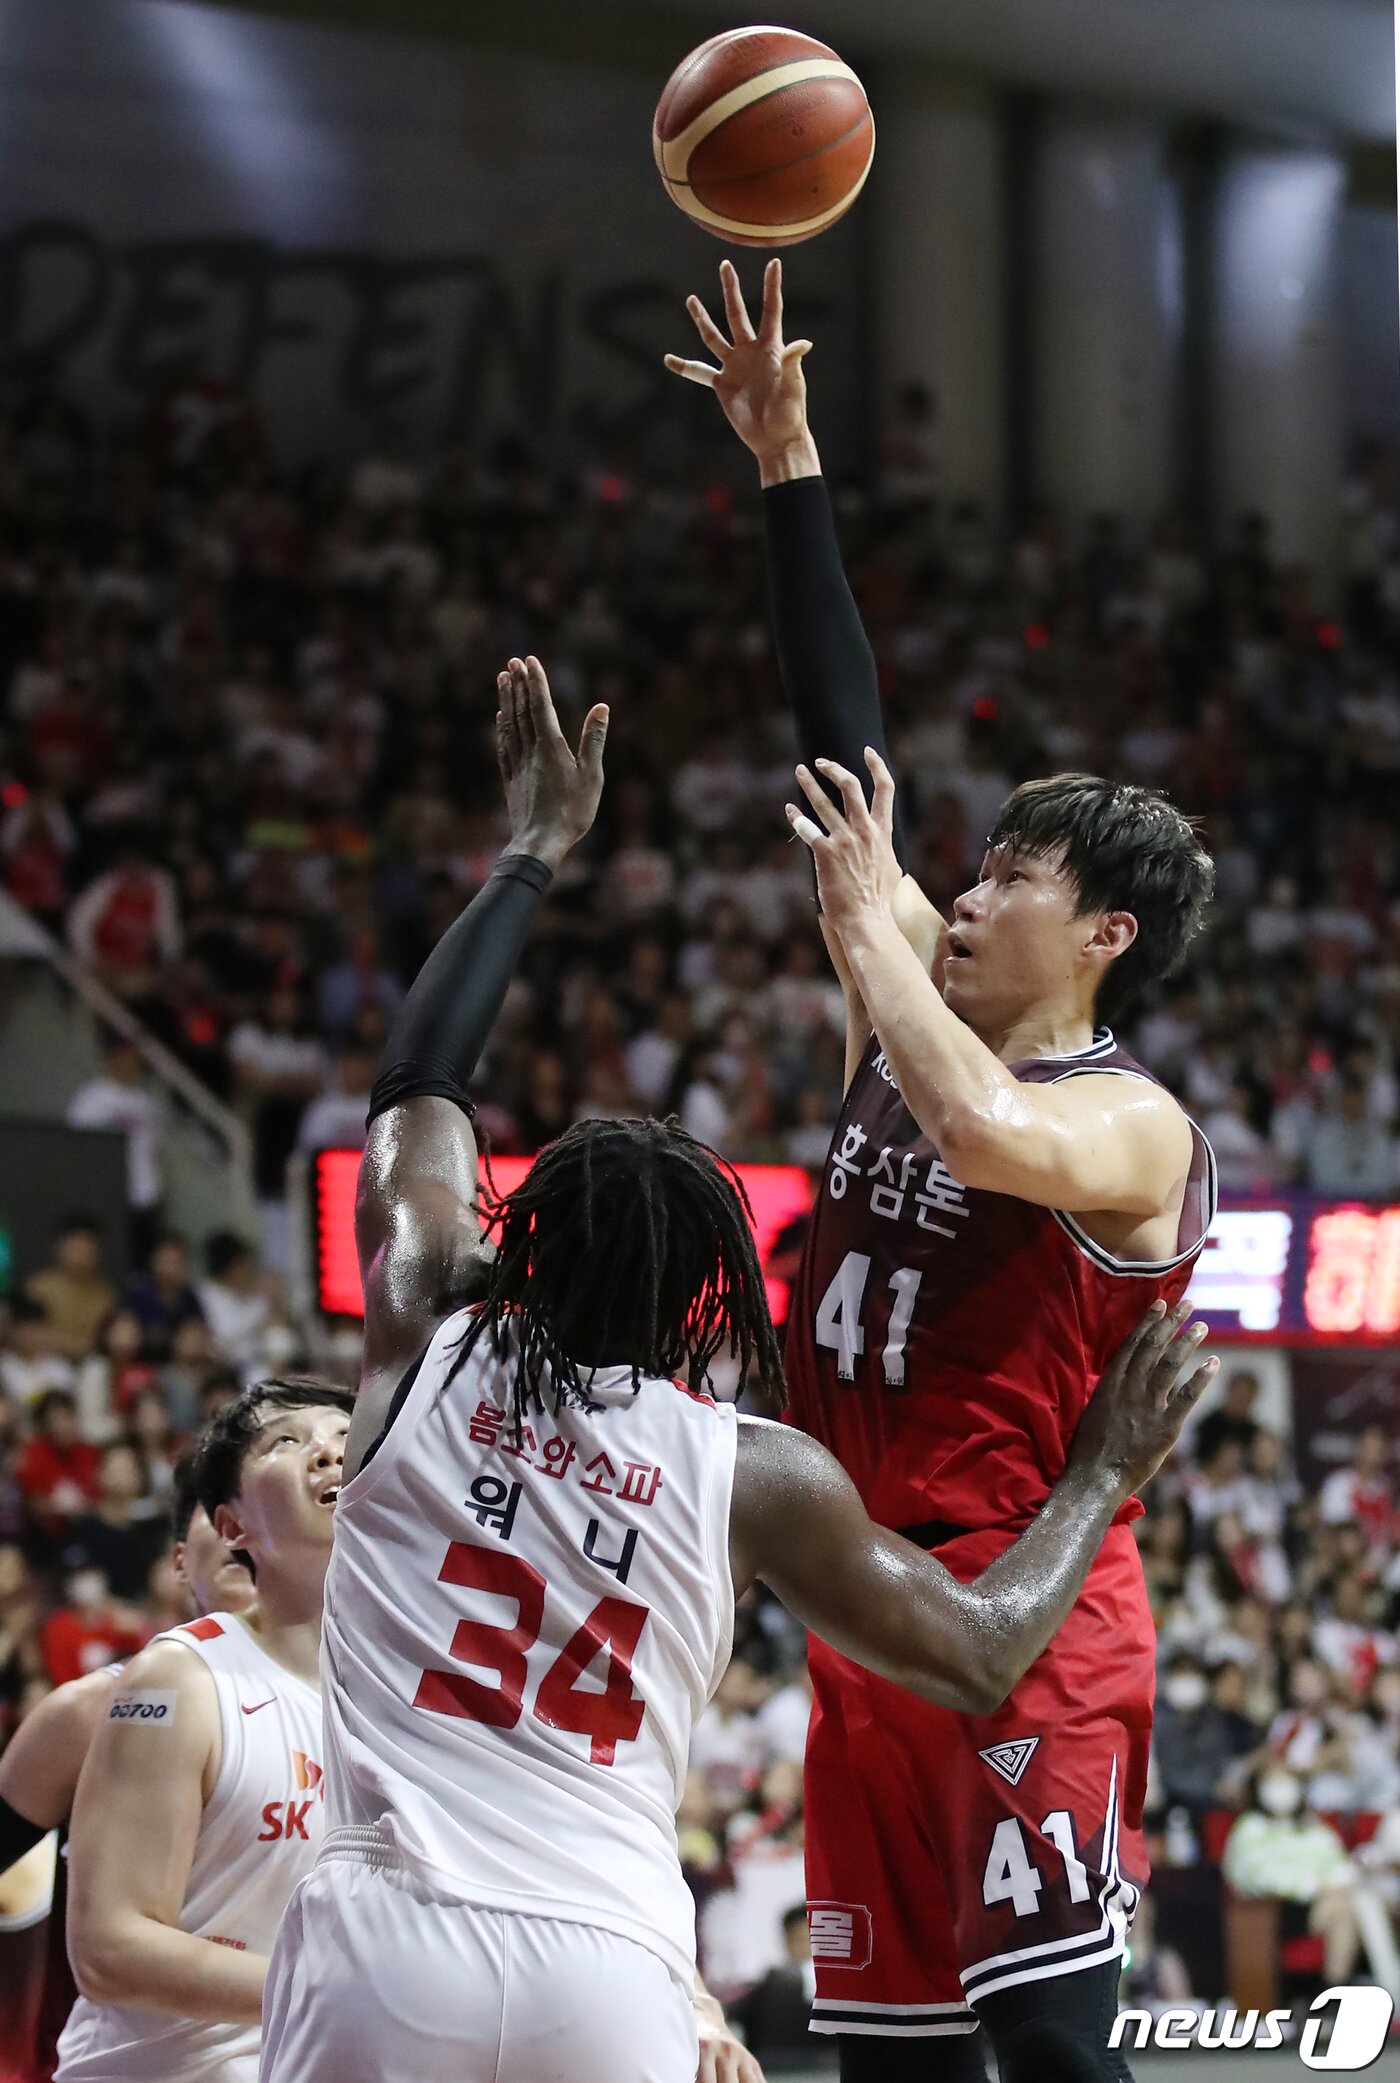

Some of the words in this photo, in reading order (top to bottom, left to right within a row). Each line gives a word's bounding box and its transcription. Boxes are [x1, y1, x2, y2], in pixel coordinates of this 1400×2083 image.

[0, 218, 832, 432] DEFENS
[829, 1123, 970, 1239] 홍삼톤
[815, 1250, 923, 1386] 41
[412, 1541, 650, 1767] 34
[256, 1800, 316, 1841] SK
[982, 1810, 1092, 1918] 41
